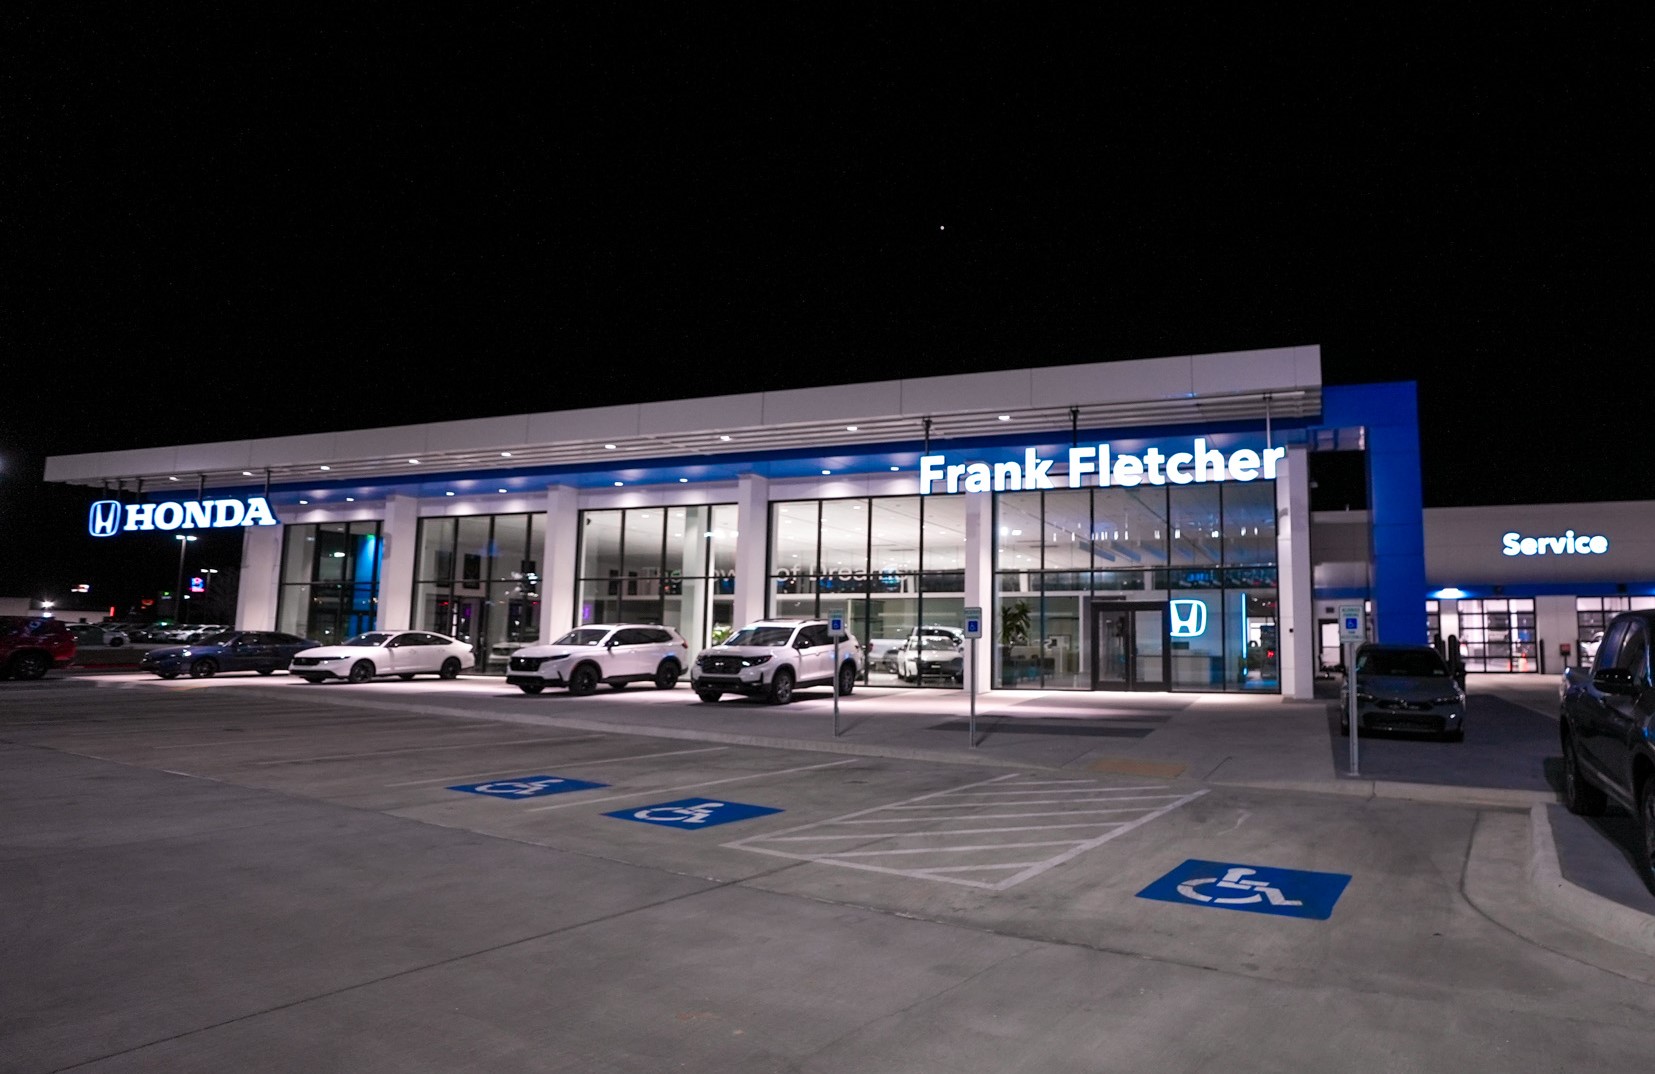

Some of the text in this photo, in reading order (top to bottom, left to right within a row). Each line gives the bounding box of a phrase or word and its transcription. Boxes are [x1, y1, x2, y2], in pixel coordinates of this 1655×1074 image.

[919, 438, 1286, 495] Frank Fletcher
[123, 497, 277, 531] HONDA
[1503, 529, 1608, 556] Service
